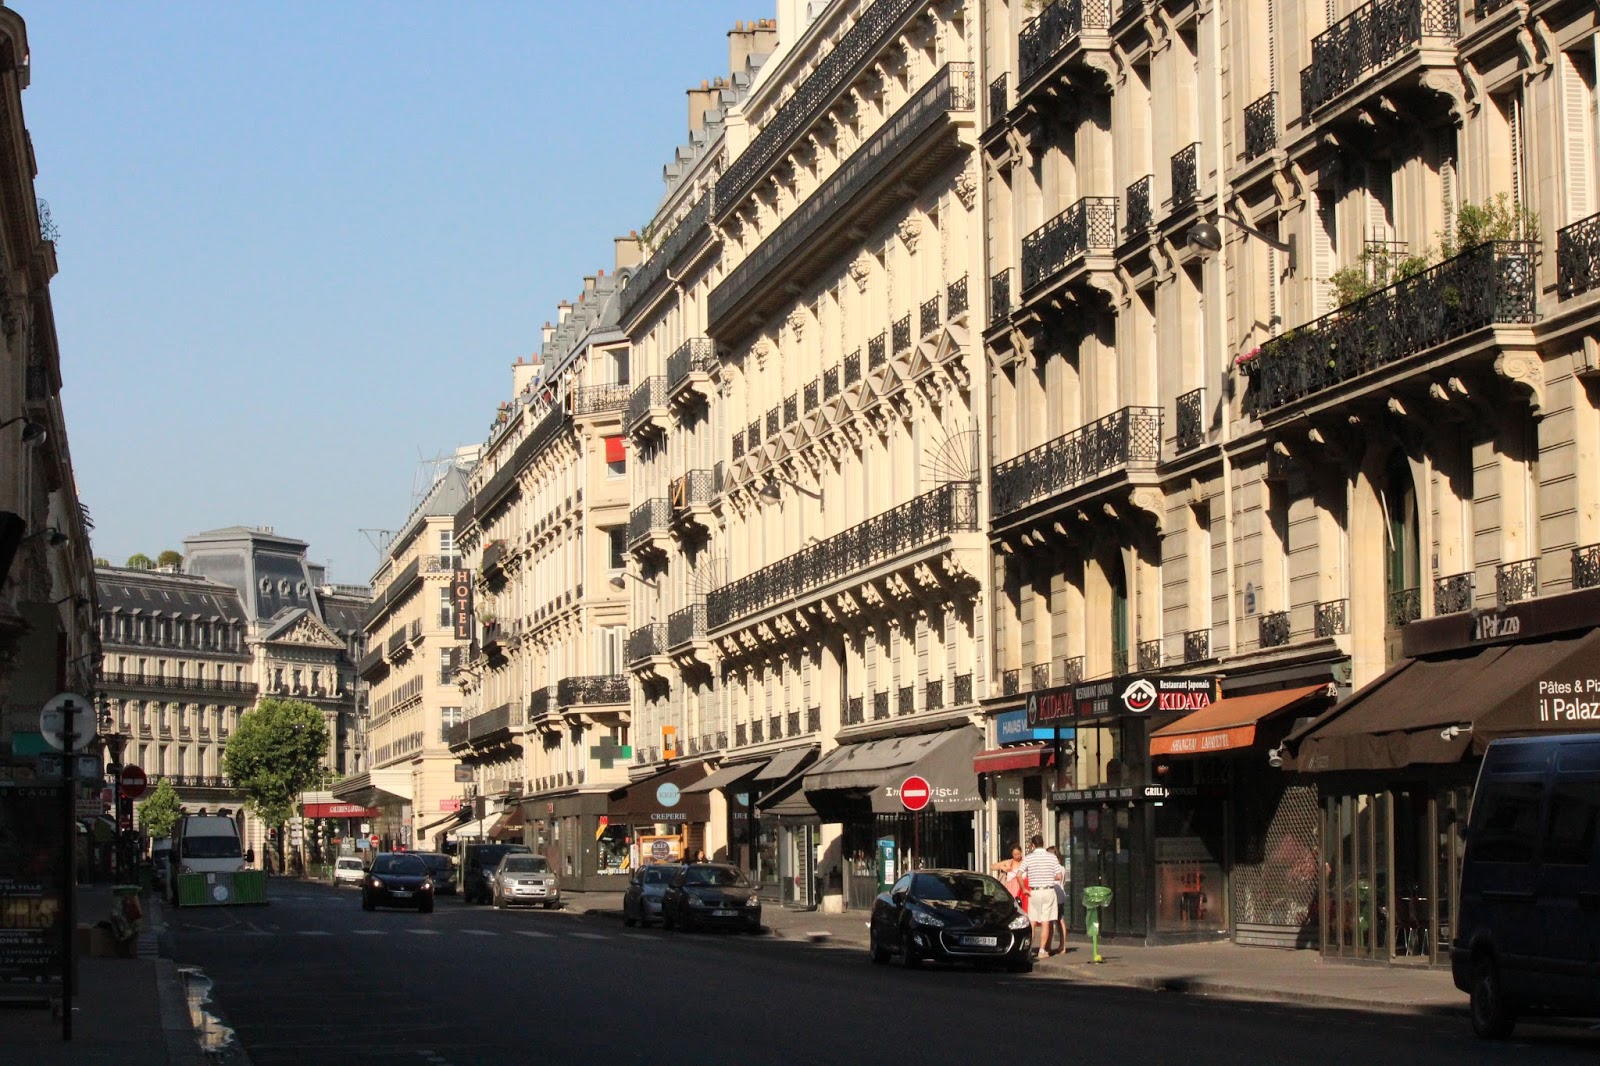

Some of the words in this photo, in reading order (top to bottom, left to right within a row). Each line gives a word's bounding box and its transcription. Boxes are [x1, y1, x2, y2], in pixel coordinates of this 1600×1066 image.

[456, 571, 468, 637] HOTEL
[1159, 680, 1187, 689] Restaurant
[1188, 680, 1210, 691] Japonais
[1539, 681, 1572, 694] Pâtes
[1574, 680, 1583, 693] &
[1039, 692, 1075, 720] KIDAYA
[1159, 692, 1211, 710] KIDAYA
[1540, 699, 1549, 721] il
[1144, 787, 1164, 796] GRILL
